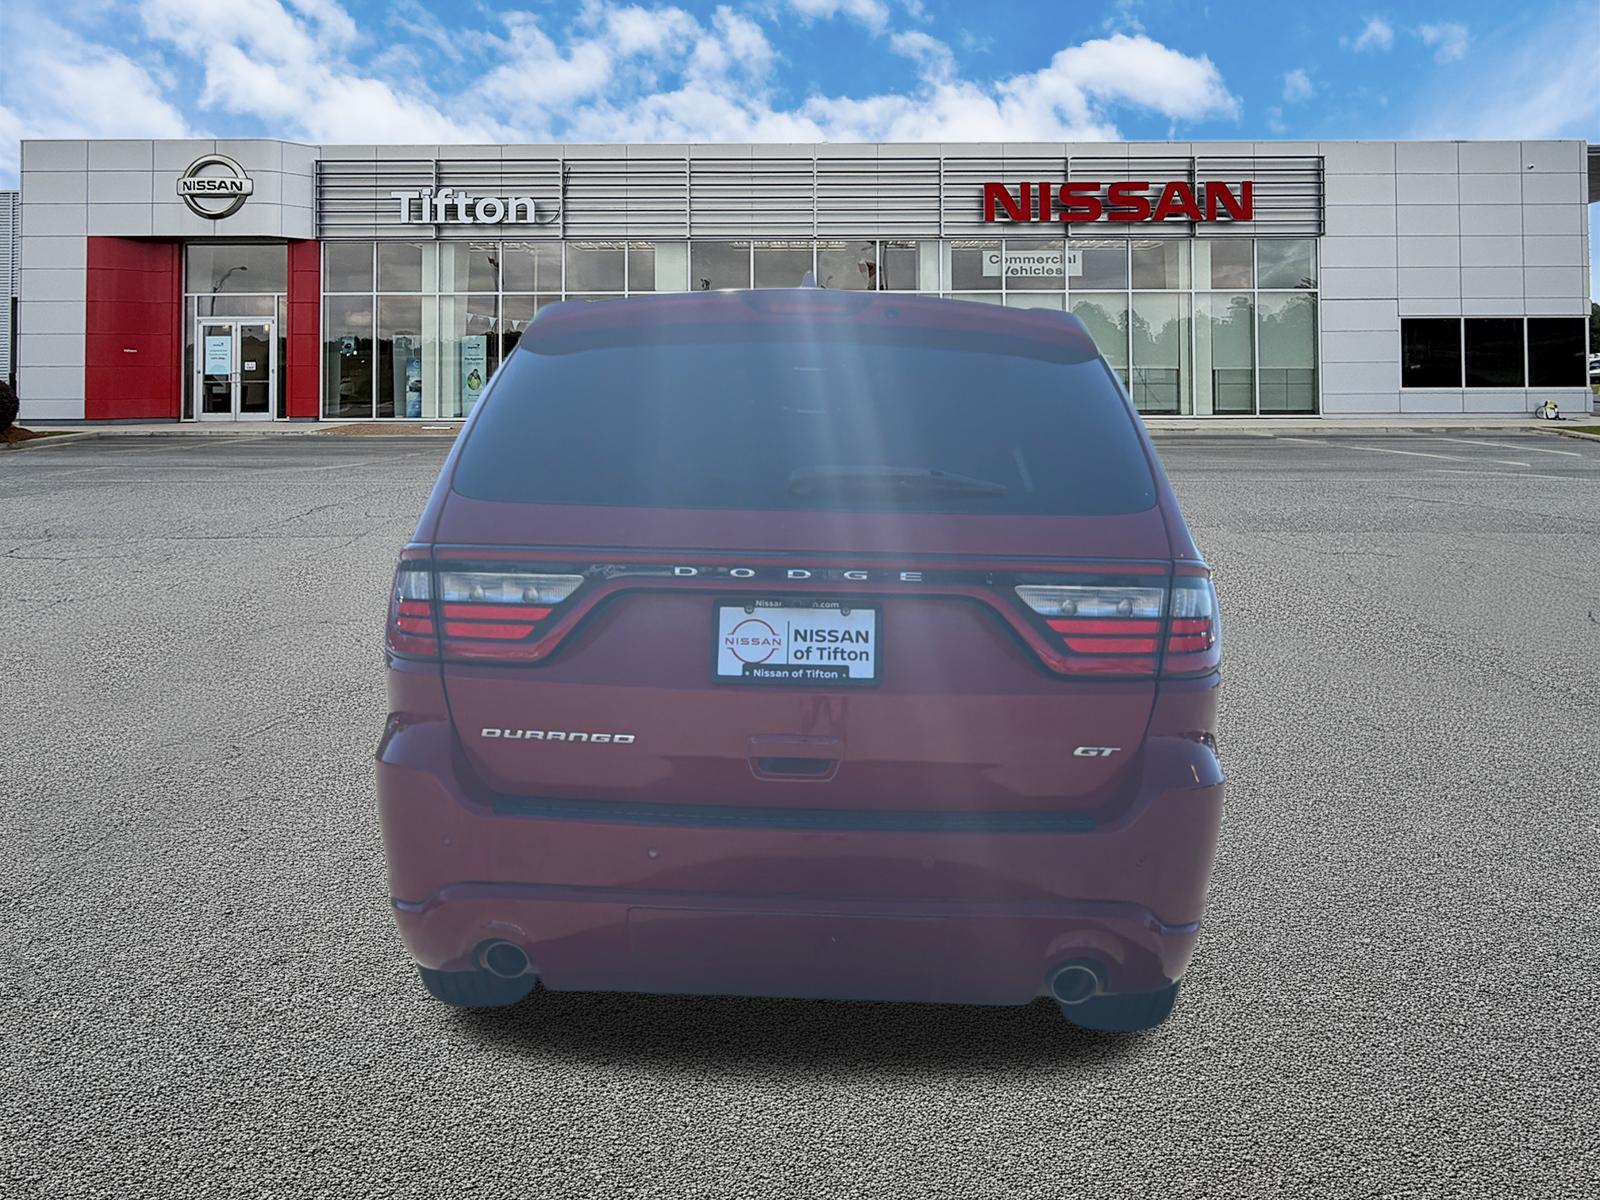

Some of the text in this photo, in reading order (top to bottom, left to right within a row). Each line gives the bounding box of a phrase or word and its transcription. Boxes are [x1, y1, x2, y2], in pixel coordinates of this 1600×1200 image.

[183, 180, 243, 191] NISSAN
[391, 187, 536, 224] Tifton
[984, 180, 1253, 222] NISSAN
[674, 566, 922, 582] DODGE
[724, 637, 782, 646] NISSAN
[793, 629, 869, 643] NISSAN
[793, 646, 869, 661] of Tifton
[753, 668, 838, 679] Nissan of Tifton
[481, 728, 635, 744] DURANGO
[1073, 746, 1121, 757] GT
